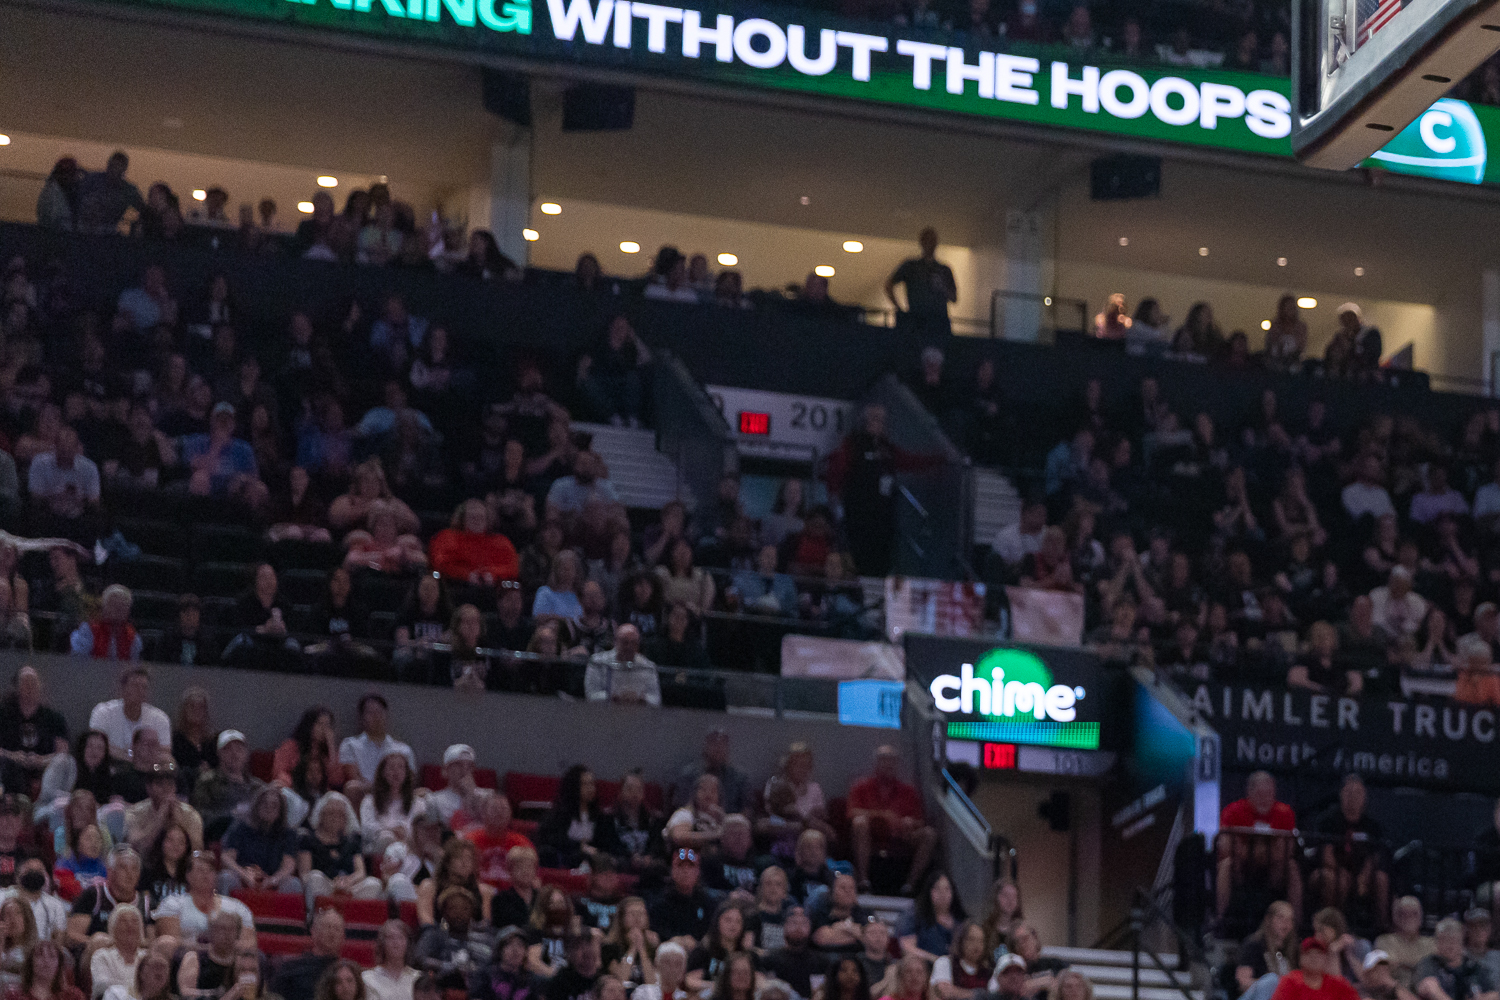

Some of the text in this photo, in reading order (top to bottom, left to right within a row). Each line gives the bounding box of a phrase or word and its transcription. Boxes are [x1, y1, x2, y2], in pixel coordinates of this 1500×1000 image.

[546, 0, 888, 82] WITHOUT
[896, 39, 1040, 105] THE
[1050, 60, 1292, 139] HOOPS
